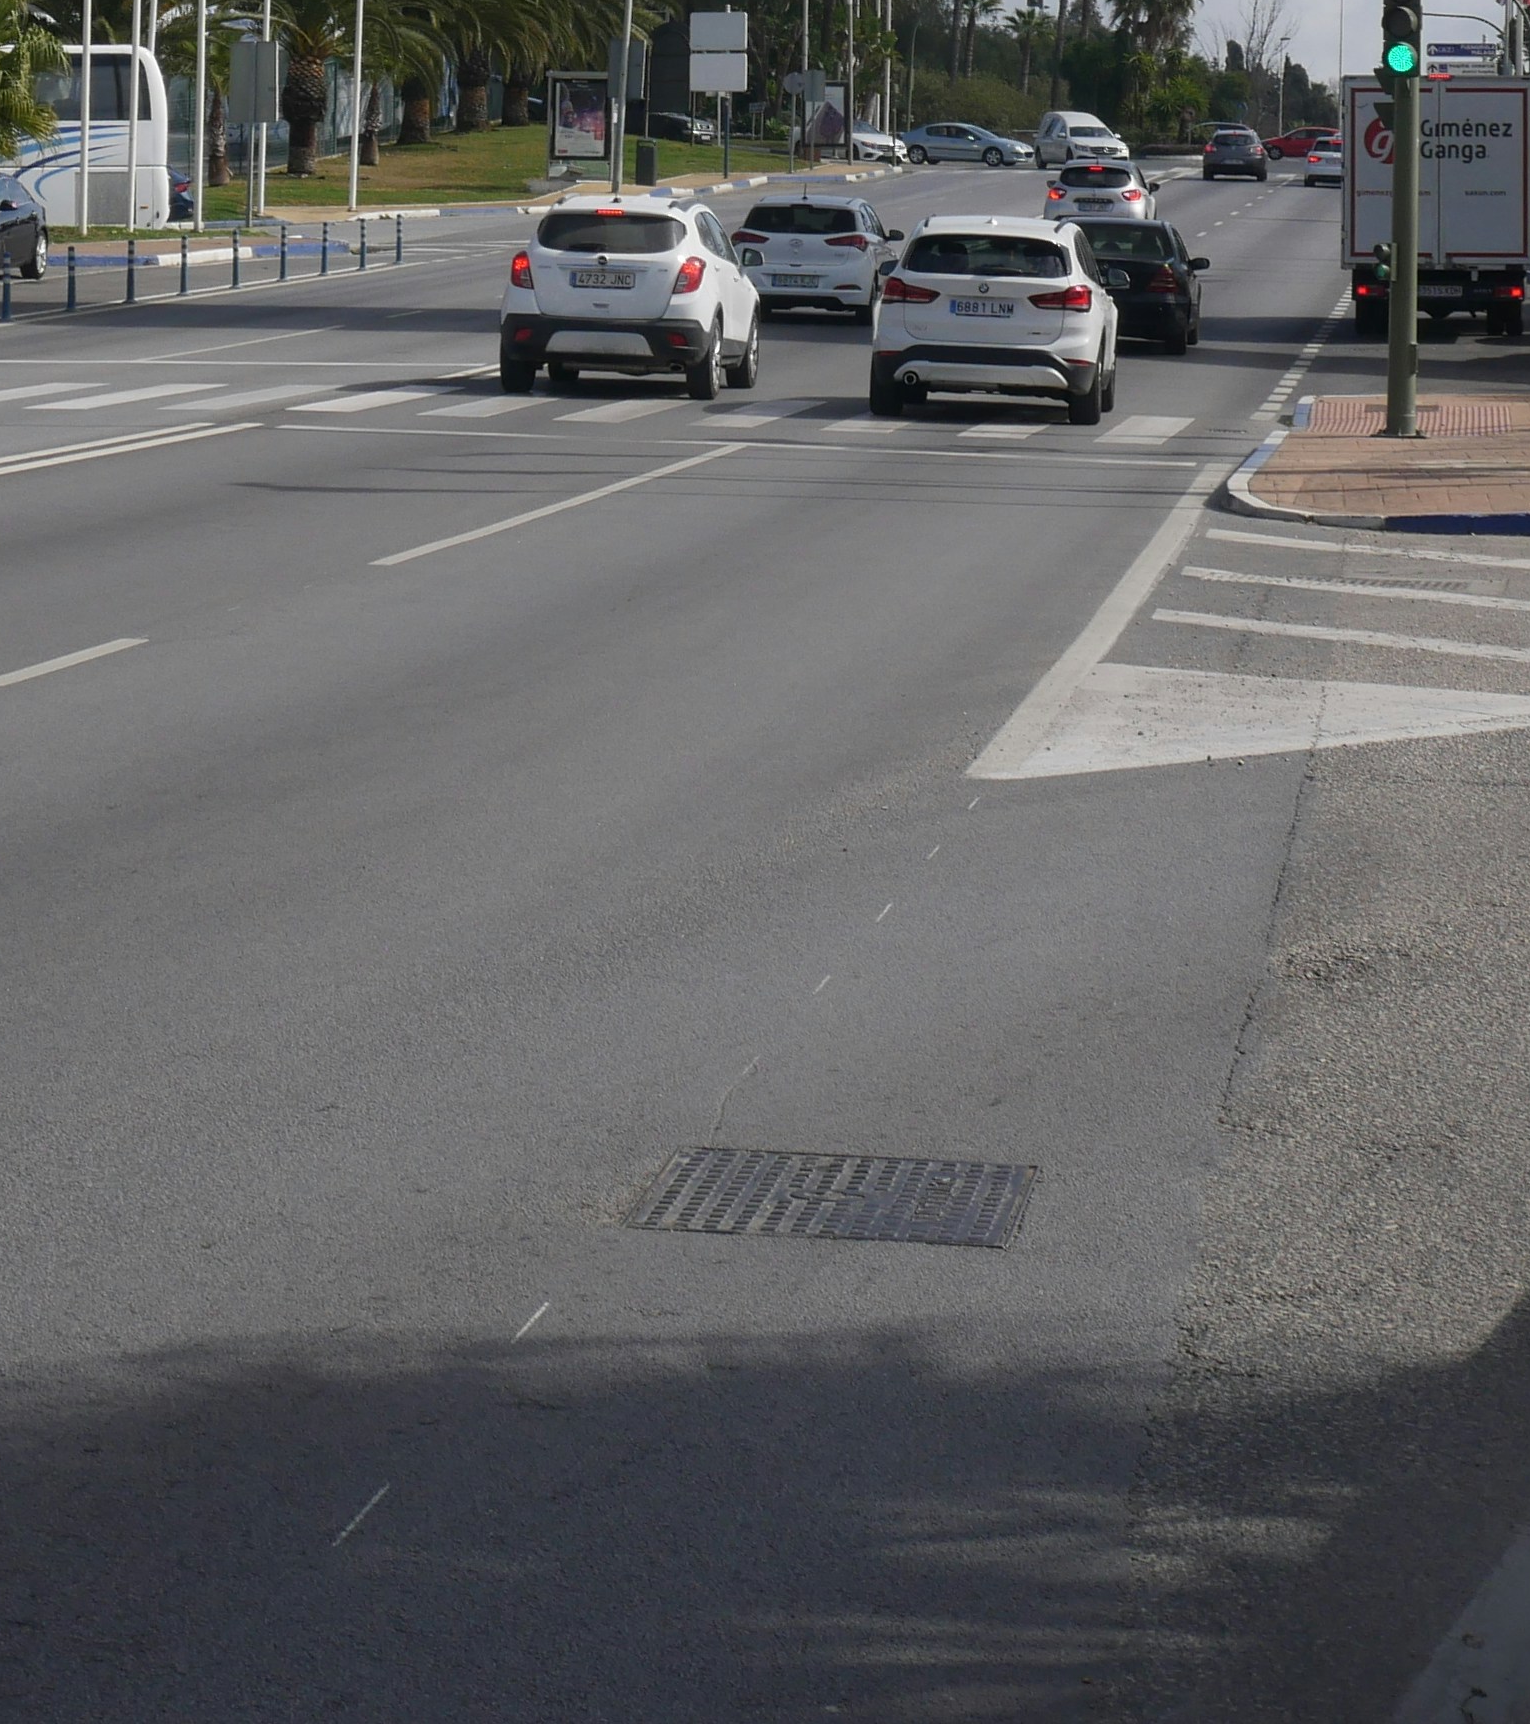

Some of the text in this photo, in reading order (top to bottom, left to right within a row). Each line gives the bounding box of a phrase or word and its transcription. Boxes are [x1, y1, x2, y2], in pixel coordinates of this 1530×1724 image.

[1420, 118, 1513, 137] Giménez
[1420, 141, 1487, 163] Ganga
[578, 274, 631, 285] 4732 JNC
[957, 302, 1014, 315] 6881 LNM
